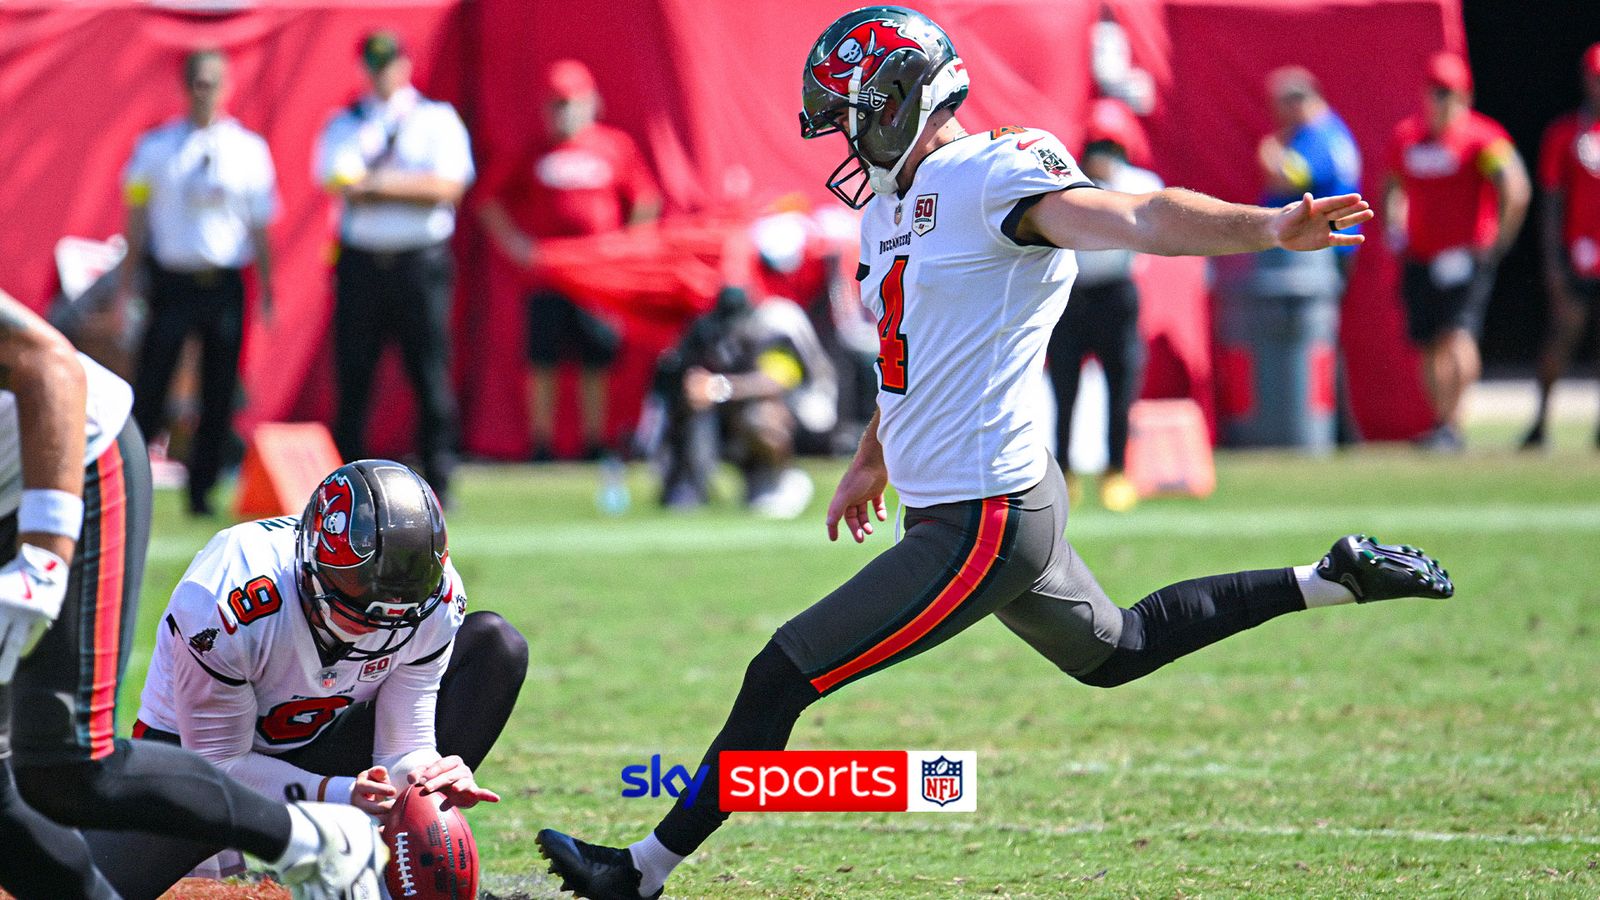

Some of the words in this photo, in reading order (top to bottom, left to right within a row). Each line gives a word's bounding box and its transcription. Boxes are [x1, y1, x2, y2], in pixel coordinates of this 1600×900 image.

[915, 198, 933, 218] 50
[877, 255, 909, 395] 4
[227, 575, 283, 626] 9
[364, 657, 389, 675] 50
